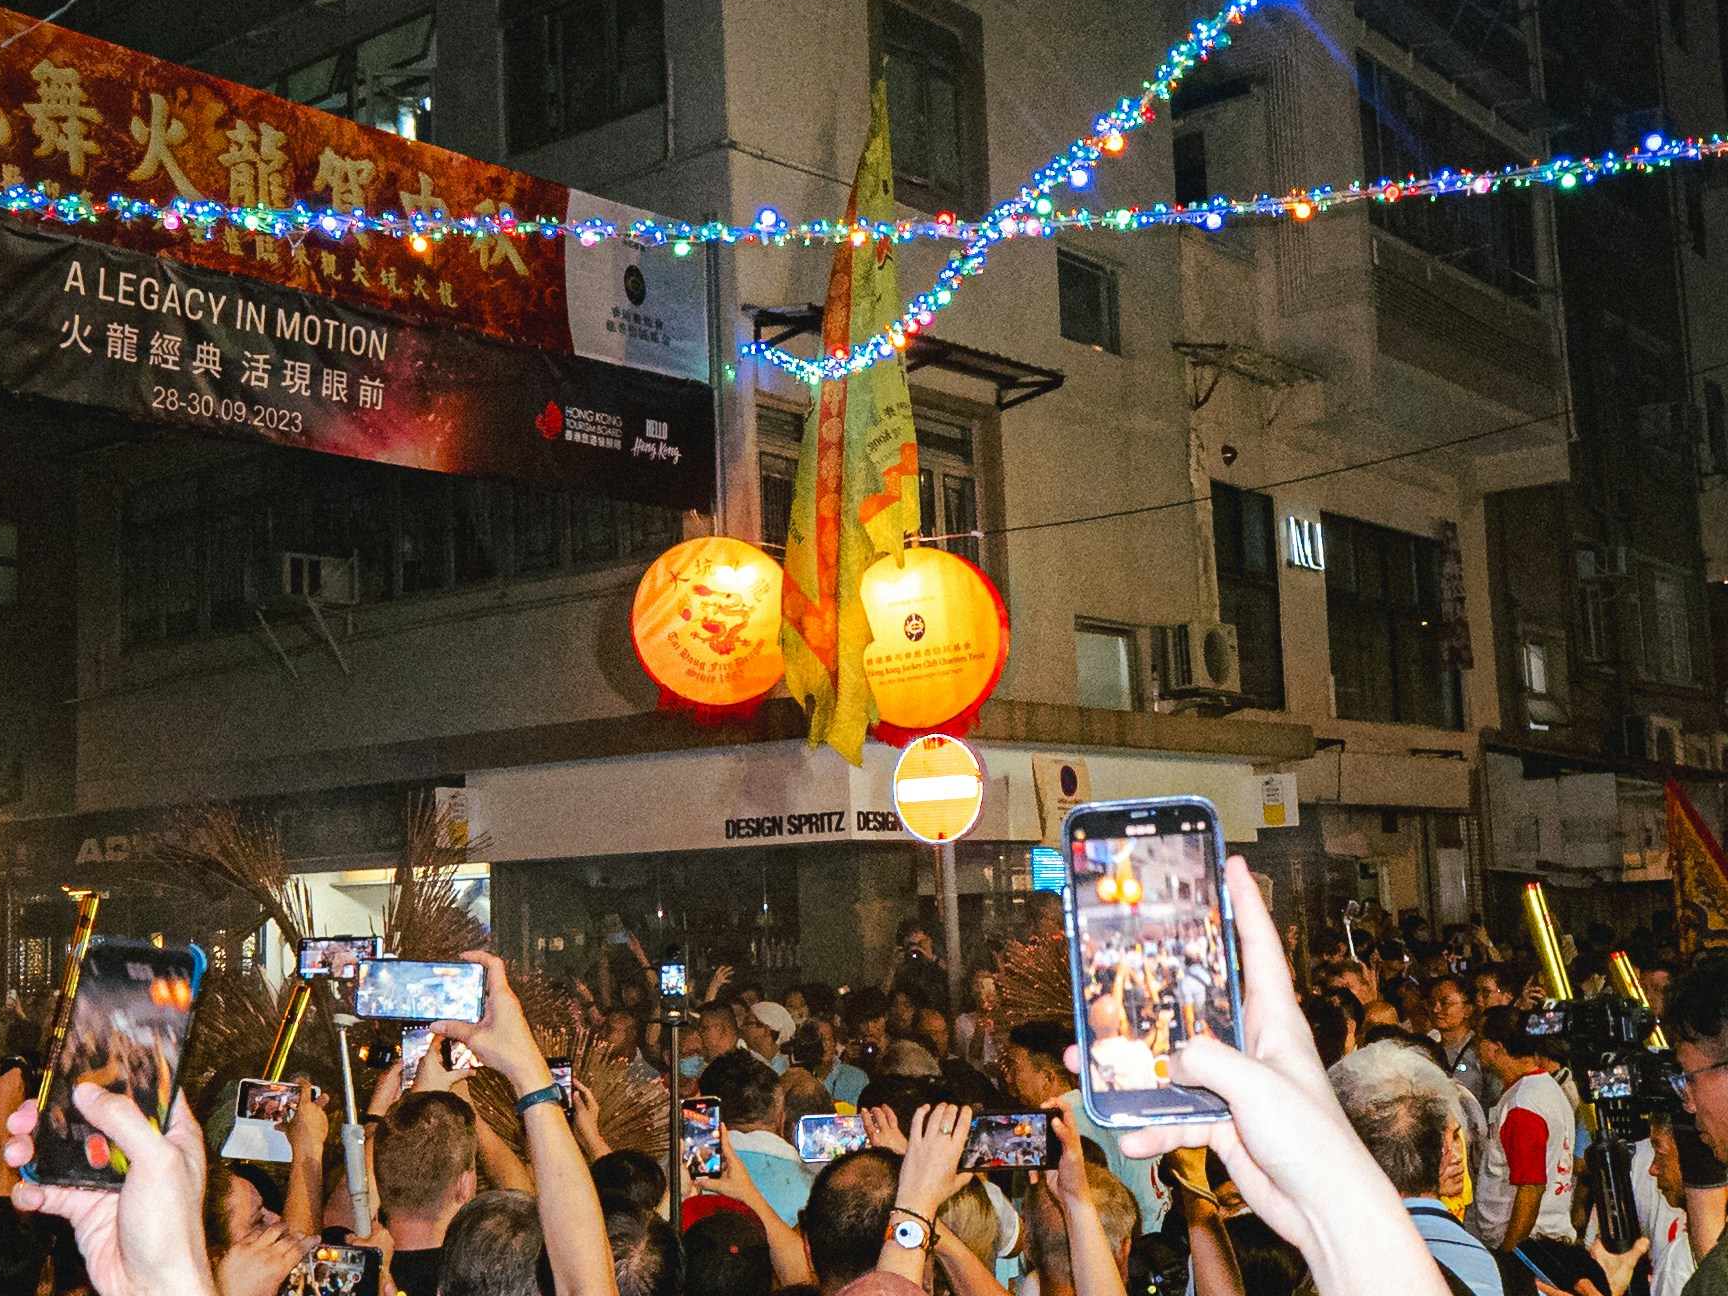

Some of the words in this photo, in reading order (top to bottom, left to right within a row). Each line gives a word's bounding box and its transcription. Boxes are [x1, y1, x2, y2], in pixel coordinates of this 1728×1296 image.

[64, 260, 86, 296] A
[98, 267, 227, 325] LEGACY
[236, 298, 266, 335] IN
[276, 307, 388, 361] MOTION
[60, 314, 223, 380] 火龍經典
[241, 350, 385, 411] 活現眼前
[152, 385, 303, 434] 28-30.09.2023
[565, 406, 593, 423] HONG
[594, 409, 622, 427] KONG
[725, 815, 784, 840] DESIGN
[787, 810, 846, 836] SPRITZ
